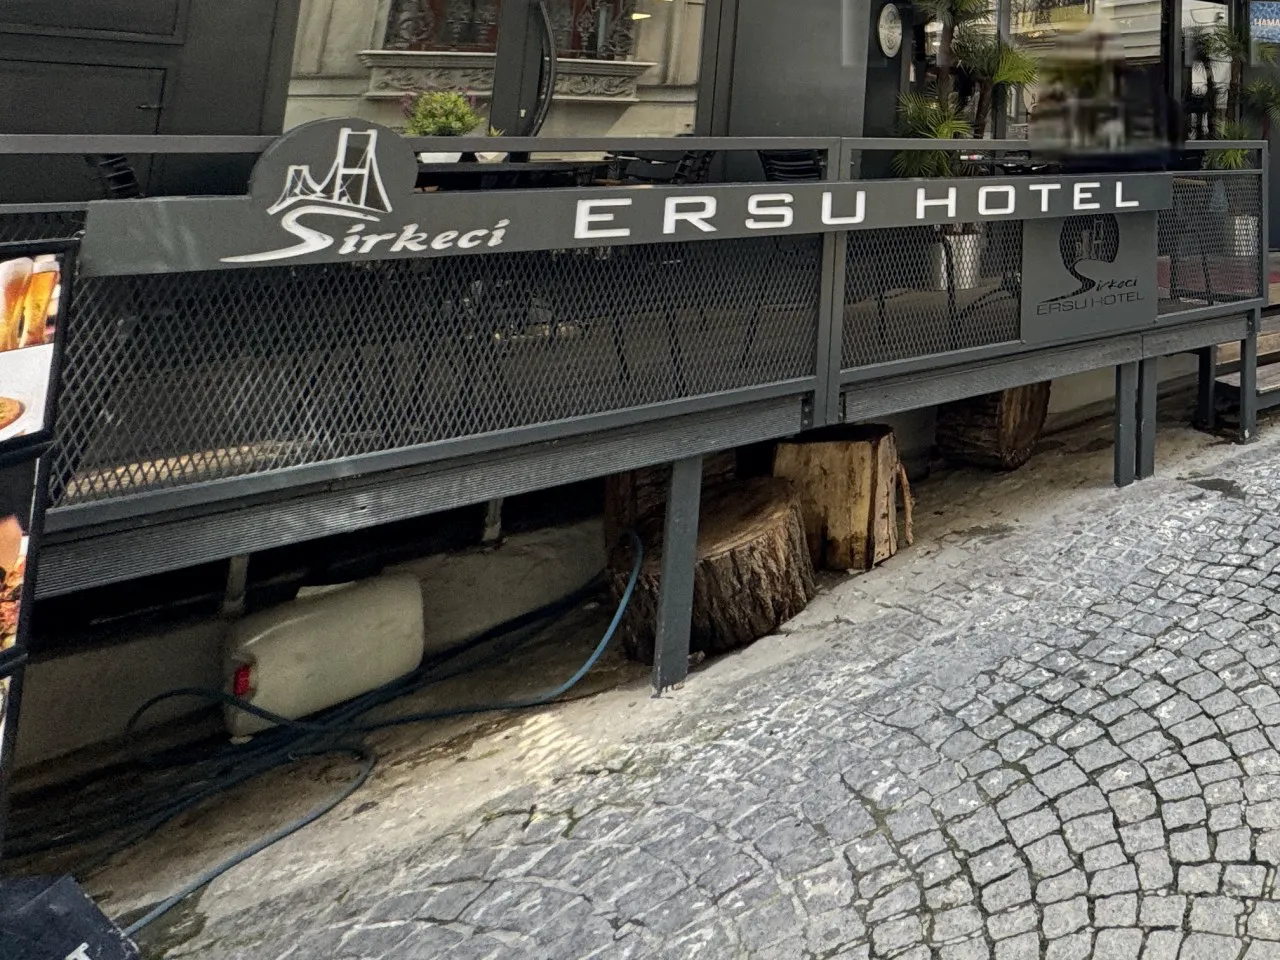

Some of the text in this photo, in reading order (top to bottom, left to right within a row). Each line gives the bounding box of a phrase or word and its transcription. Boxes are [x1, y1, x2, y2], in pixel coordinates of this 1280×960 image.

[220, 181, 1139, 262] Sirkeci ERSU HOTEL
[1036, 292, 1145, 315] ERSU HOTEL
